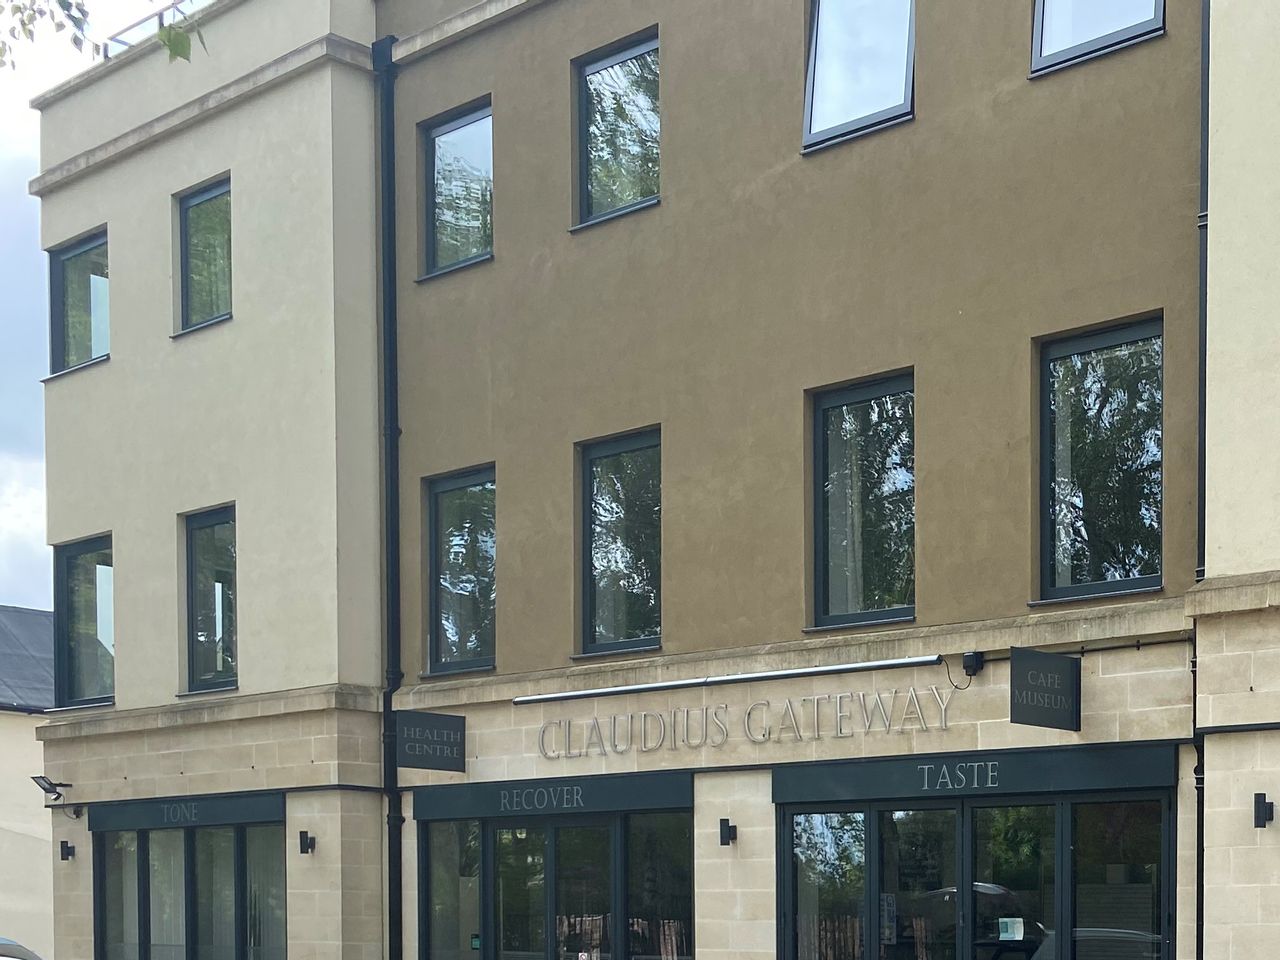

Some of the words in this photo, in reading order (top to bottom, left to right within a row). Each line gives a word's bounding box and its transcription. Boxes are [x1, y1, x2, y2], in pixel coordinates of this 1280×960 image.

[1014, 689, 1074, 712] MUSEUM
[538, 704, 728, 760] CLAUDIUS
[744, 683, 960, 744] GATEWAY
[403, 727, 461, 742] HEALTH
[405, 742, 460, 758] CENTRE
[917, 761, 999, 790] TASTE
[500, 785, 584, 811] RECOVER
[160, 802, 199, 823] TONE
